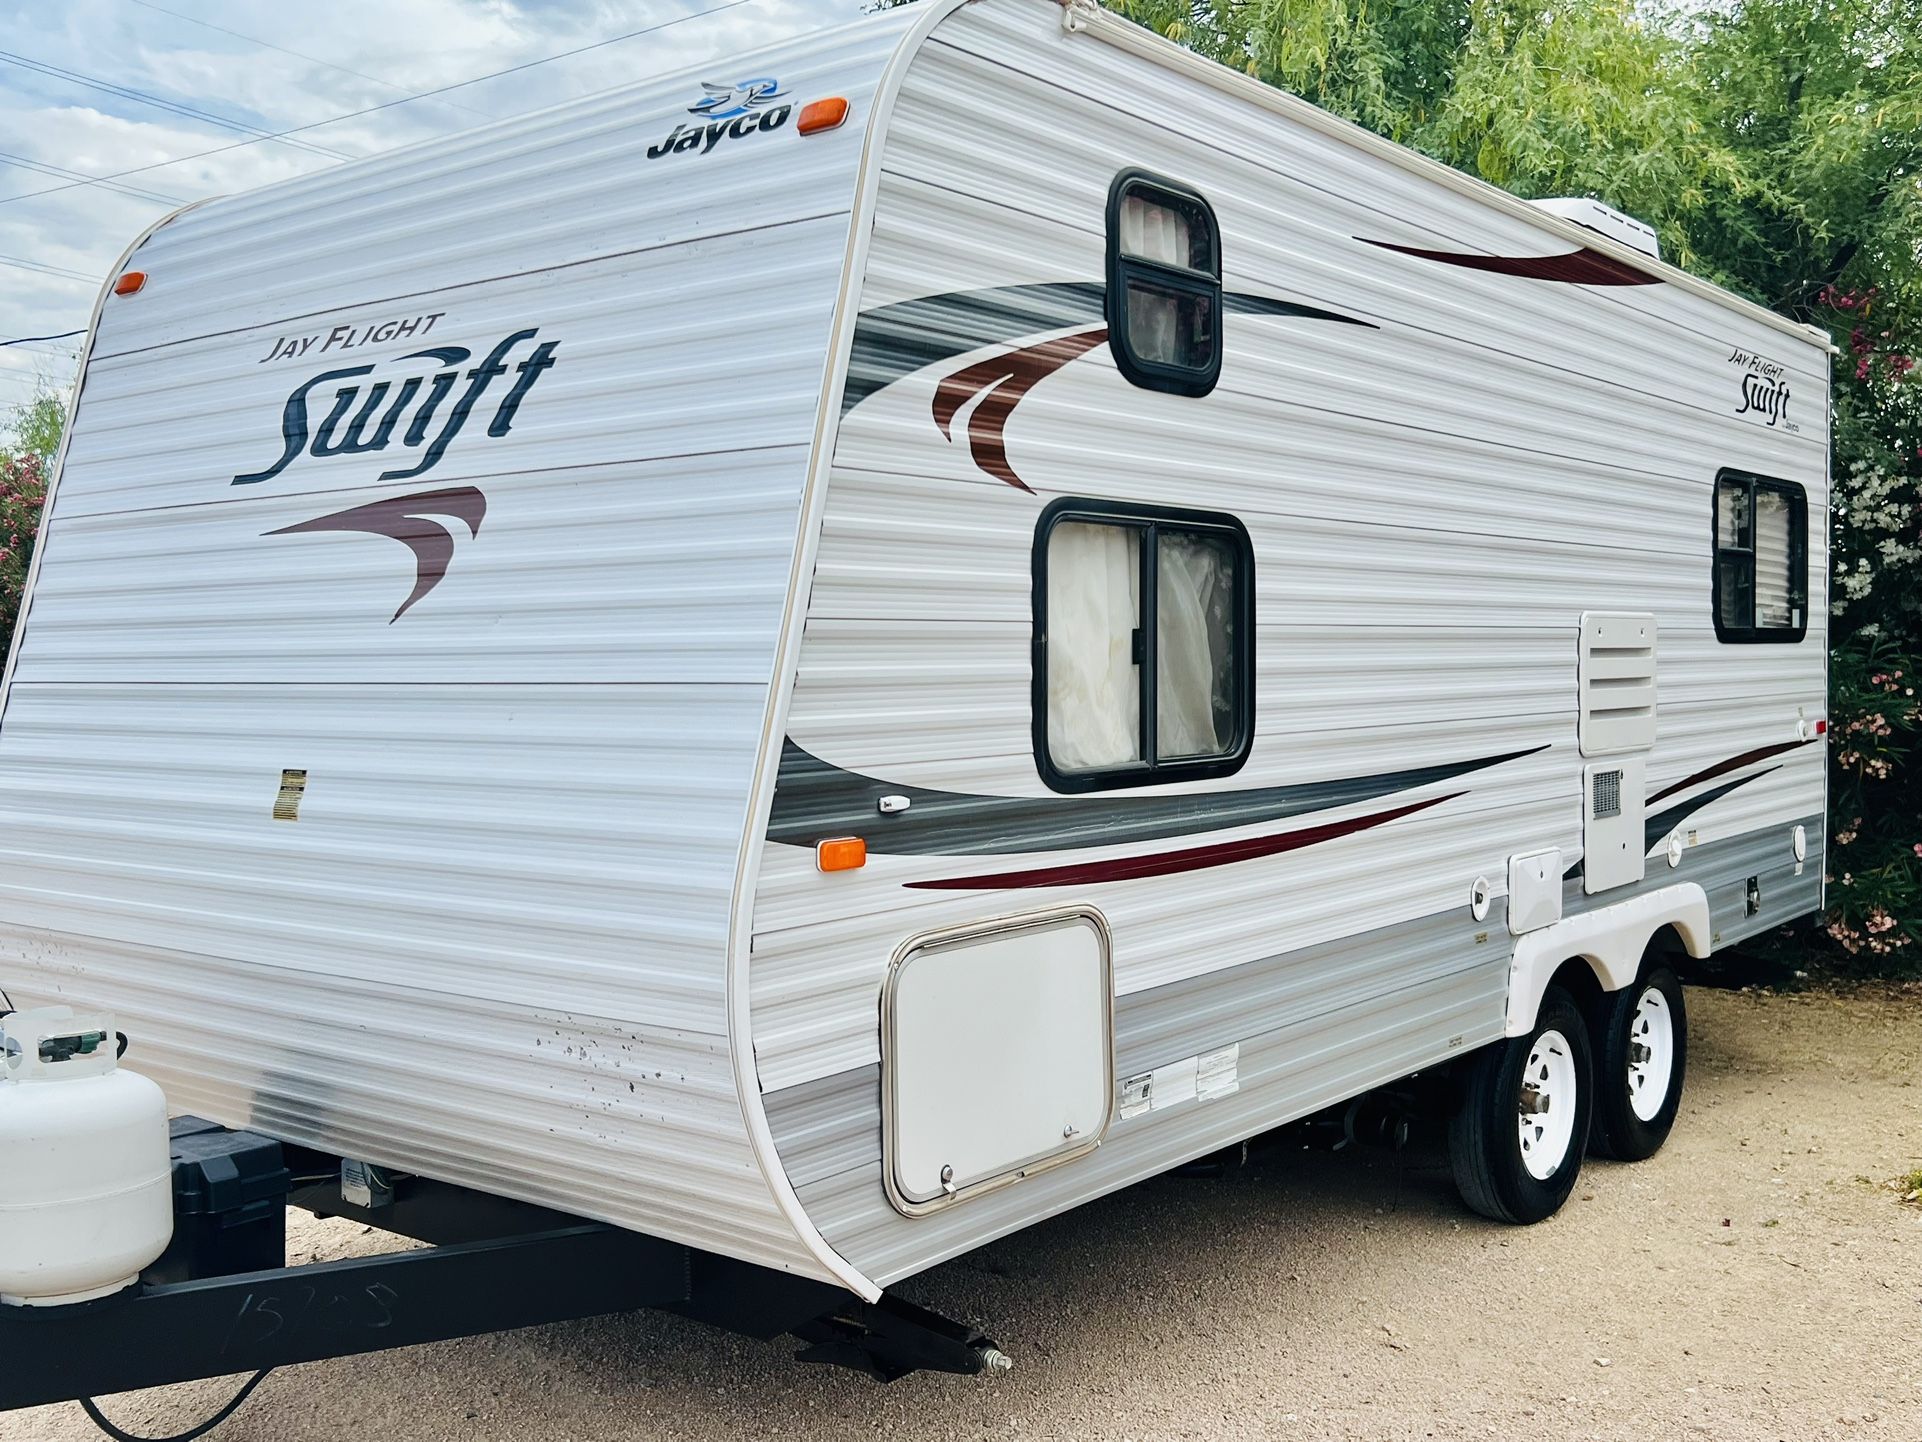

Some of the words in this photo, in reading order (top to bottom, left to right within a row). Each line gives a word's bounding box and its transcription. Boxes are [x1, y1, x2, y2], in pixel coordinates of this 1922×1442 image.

[647, 104, 791, 159] Jayco
[259, 337, 320, 363] JAY
[319, 312, 446, 353] FLIGHT
[1727, 349, 1749, 367] JAY
[1748, 356, 1784, 379] FLIGHT
[230, 327, 562, 486] Swift
[1735, 373, 1790, 426] Swift
